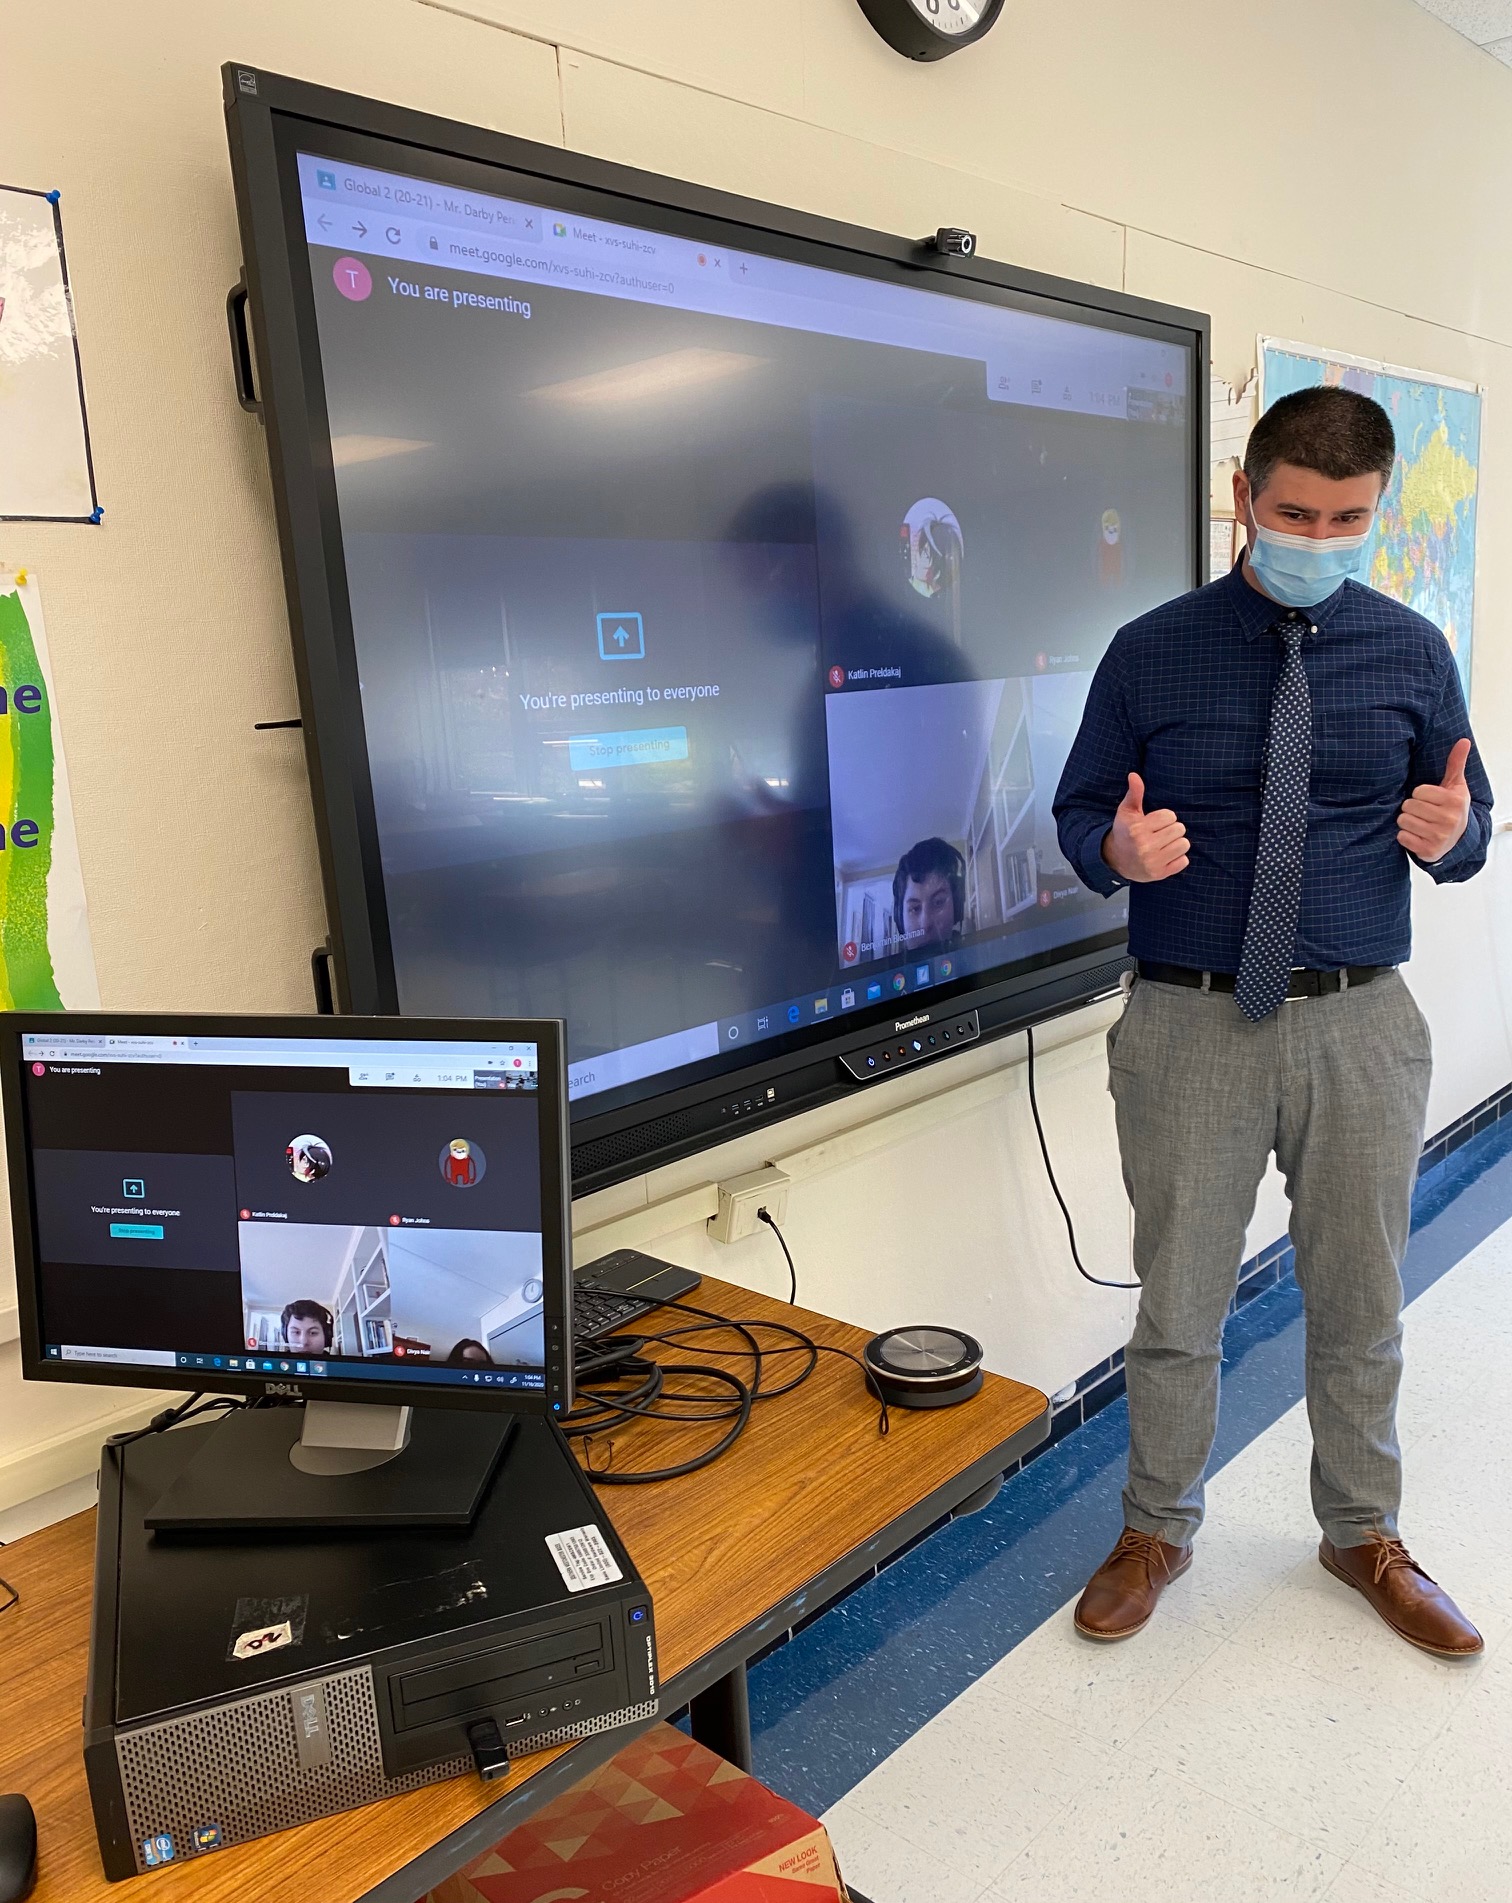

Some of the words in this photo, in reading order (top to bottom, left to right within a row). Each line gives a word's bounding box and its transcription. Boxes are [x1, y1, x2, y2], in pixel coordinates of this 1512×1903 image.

[344, 178, 381, 196] Global
[384, 187, 391, 199] 2
[394, 190, 433, 210] (20-21)
[444, 200, 461, 214] Mr.
[465, 204, 494, 224] Darby
[573, 227, 596, 242] Meet
[345, 270, 359, 288] T
[387, 276, 420, 297] You
[424, 286, 449, 301] are
[453, 289, 531, 319] presenting
[848, 669, 868, 680] Katlin
[520, 693, 567, 710] You're
[571, 687, 644, 710] presenting
[647, 686, 660, 701] to
[664, 684, 720, 702] everyone
[590, 745, 613, 758] Stop
[616, 739, 670, 756] presenting
[895, 1014, 930, 1031] Promethean
[72, 1067, 101, 1075] presenting
[111, 1208, 143, 1216] presenting
[265, 1383, 302, 1396] DELL
[301, 1694, 318, 1738] DELL
[779, 1857, 795, 1872] NEW
[796, 1845, 817, 1862] LOOK
[602, 1869, 640, 1890] Copy
[641, 1846, 680, 1870] Paper
